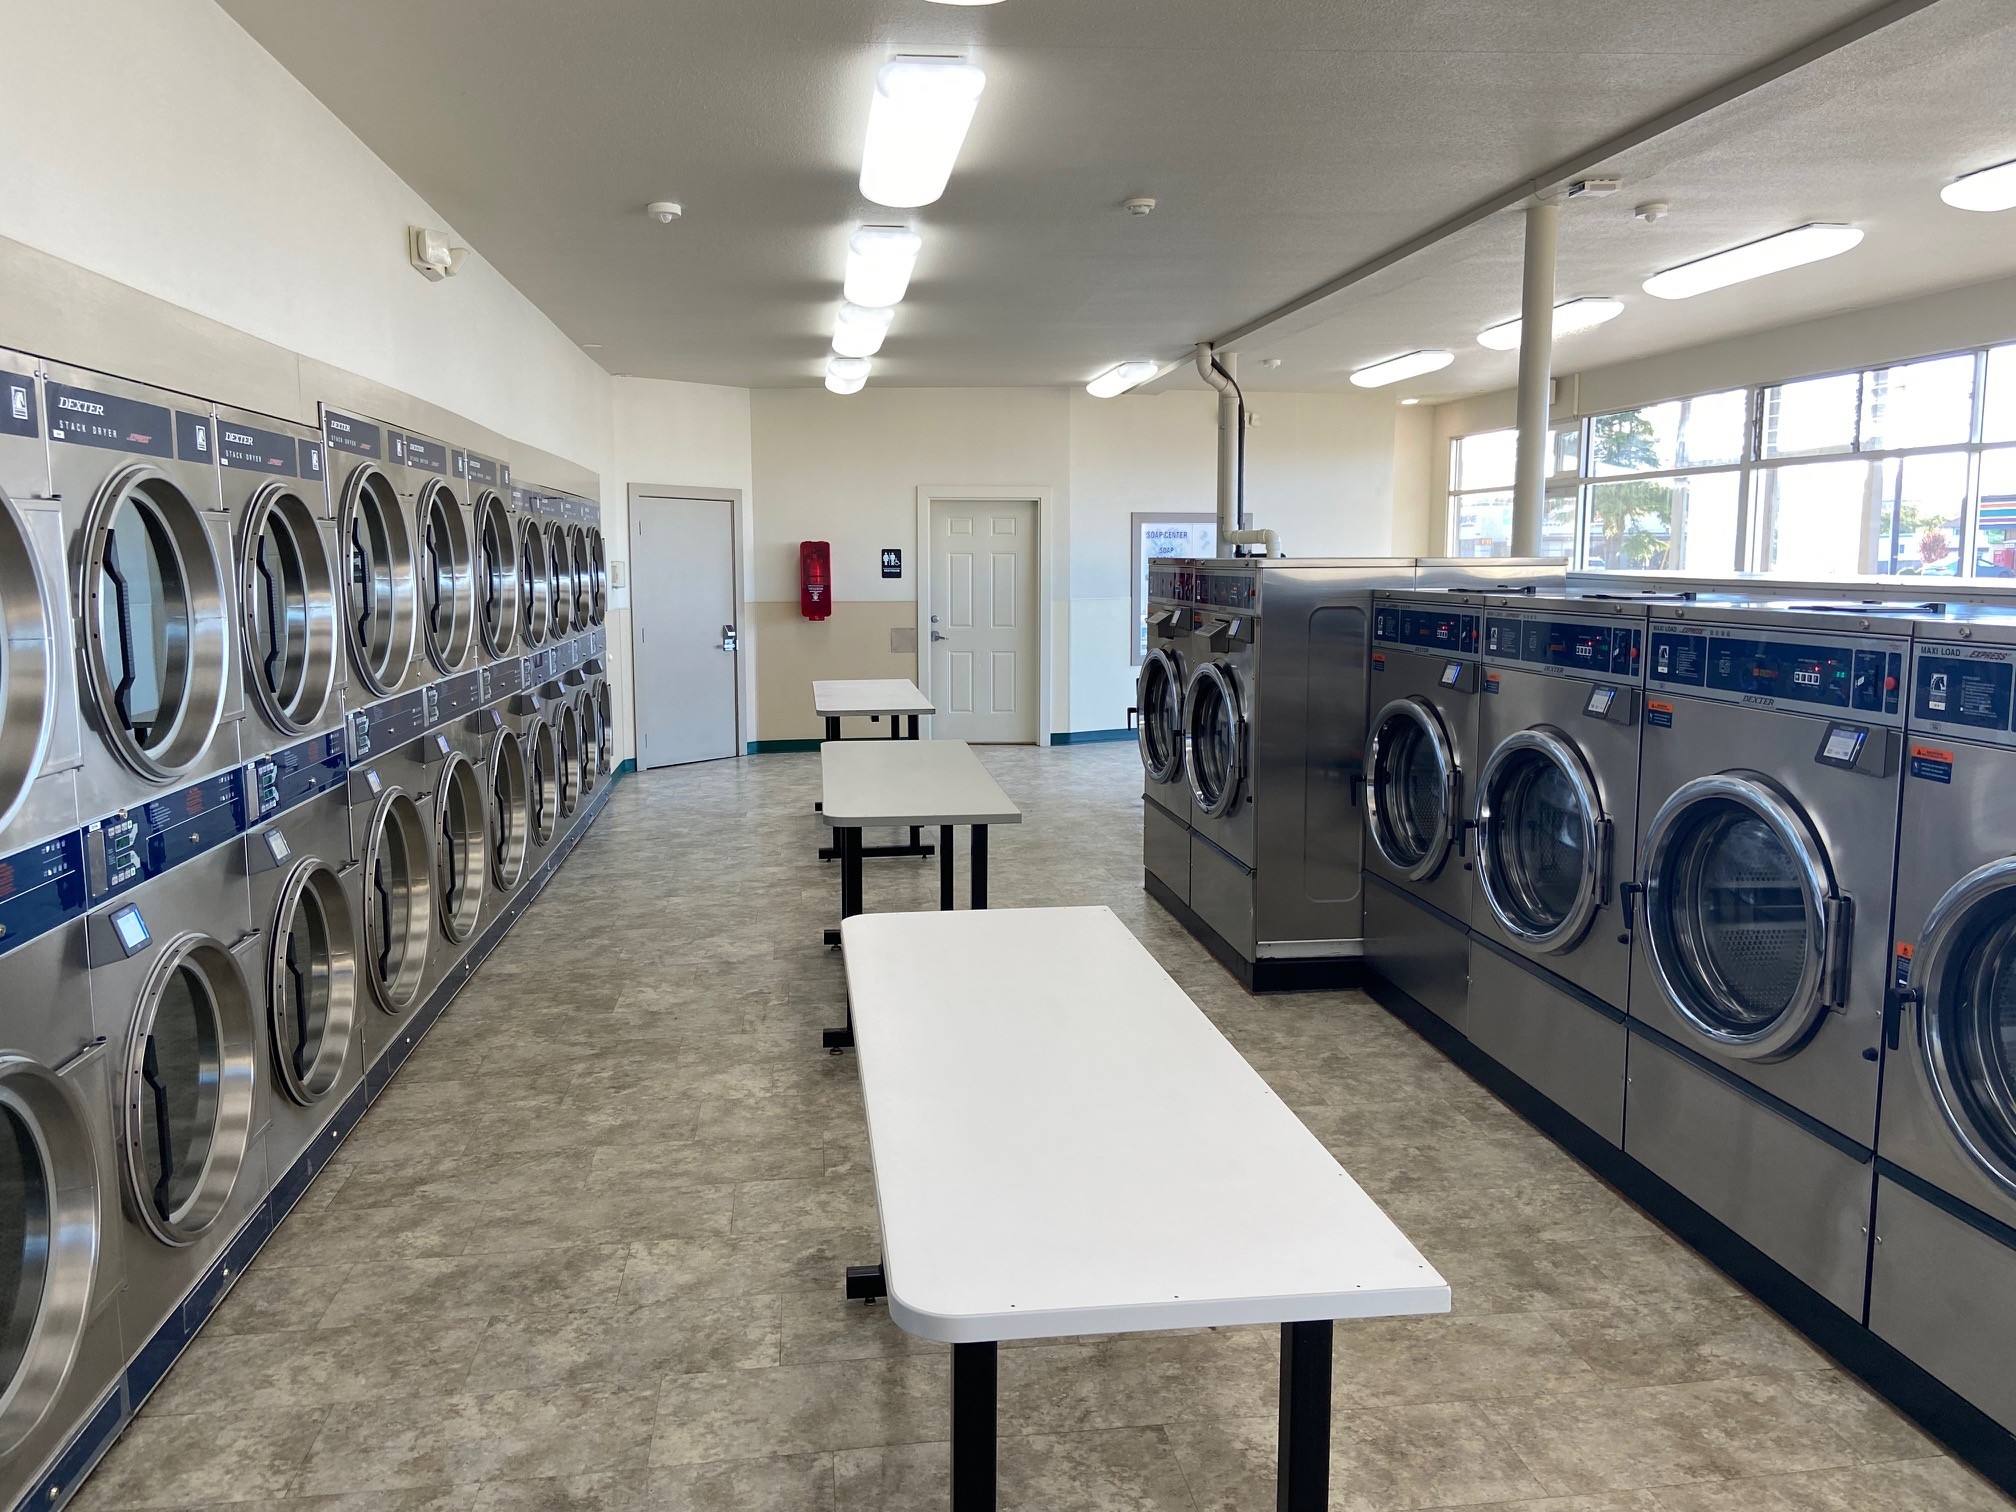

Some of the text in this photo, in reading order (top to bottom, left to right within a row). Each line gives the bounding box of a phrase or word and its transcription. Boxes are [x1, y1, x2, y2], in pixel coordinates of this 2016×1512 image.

[58, 396, 105, 416] DEXTER
[59, 419, 118, 438] STACK DRYER
[330, 420, 351, 433] DEXTER
[225, 431, 254, 446] DEXTER
[225, 449, 243, 460] STACK
[246, 453, 262, 463] DRYER
[1146, 531, 1188, 539] SOAP CENTER
[1920, 646, 2008, 660] MAXI LOAD EXPRESS
[1543, 665, 1565, 674] DEXTER
[1742, 695, 1775, 706] DEXTER
